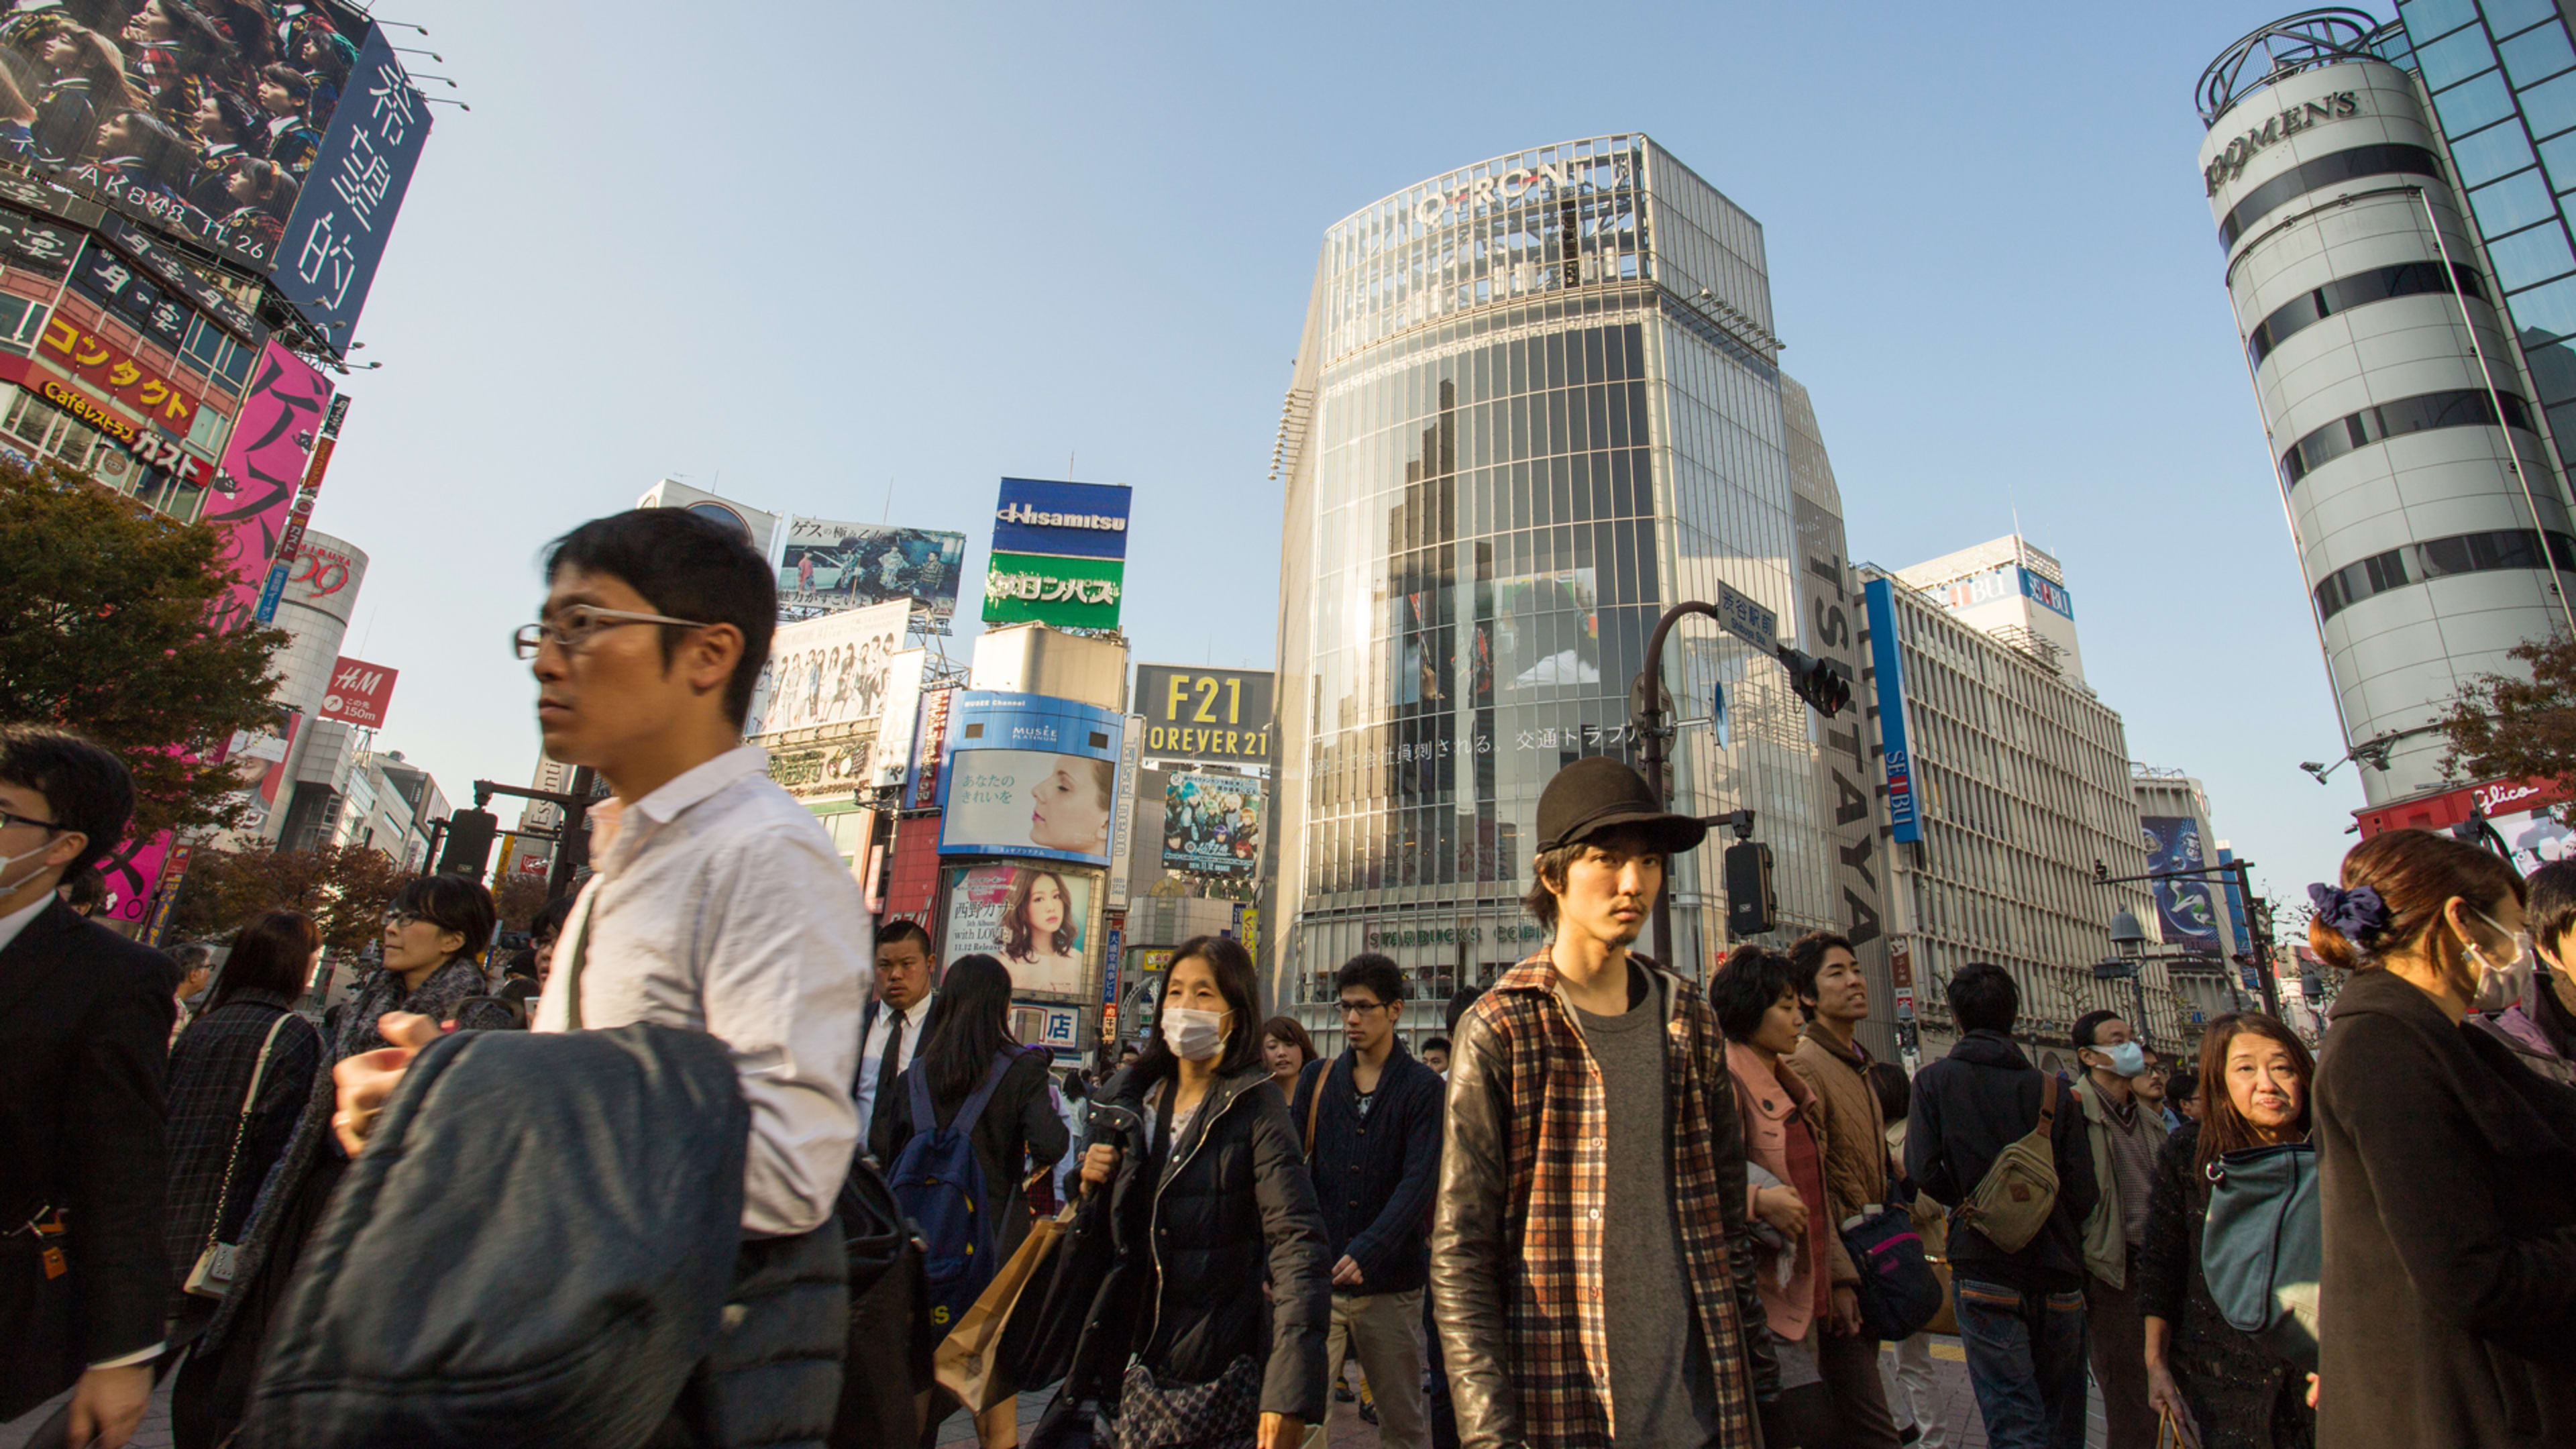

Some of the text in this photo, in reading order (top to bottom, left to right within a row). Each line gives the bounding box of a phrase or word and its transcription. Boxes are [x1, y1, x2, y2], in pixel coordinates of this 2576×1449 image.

[79, 166, 186, 222] AKB48
[43, 317, 189, 419] コンタクト
[131, 429, 199, 478] ガスト
[997, 502, 1126, 532] Hisamitsu
[299, 543, 352, 567] HIBUYA
[1935, 571, 2008, 608] EIBU
[2029, 574, 2070, 616] SEIBU
[1722, 590, 1772, 636] 渋谷駅前
[334, 666, 382, 696] H&M
[343, 706, 376, 721] 150m
[345, 698, 370, 710] この先
[991, 699, 1026, 707] Channel
[1167, 674, 1241, 724] F21
[1147, 727, 1267, 755] OREVER 21
[531, 762, 562, 826] Essnti
[962, 774, 1015, 788] あなたの
[1886, 749, 1914, 825] SEIBU
[961, 790, 1012, 804] きれいを
[2473, 785, 2541, 815] Glico
[1114, 804, 1129, 857] neon
[955, 901, 1010, 920] 西野カナ
[954, 928, 975, 940] with
[954, 943, 1006, 951] 11.12 Release
[1369, 927, 1482, 949] STARBUCKS
[1047, 1014, 1072, 1040] 店
